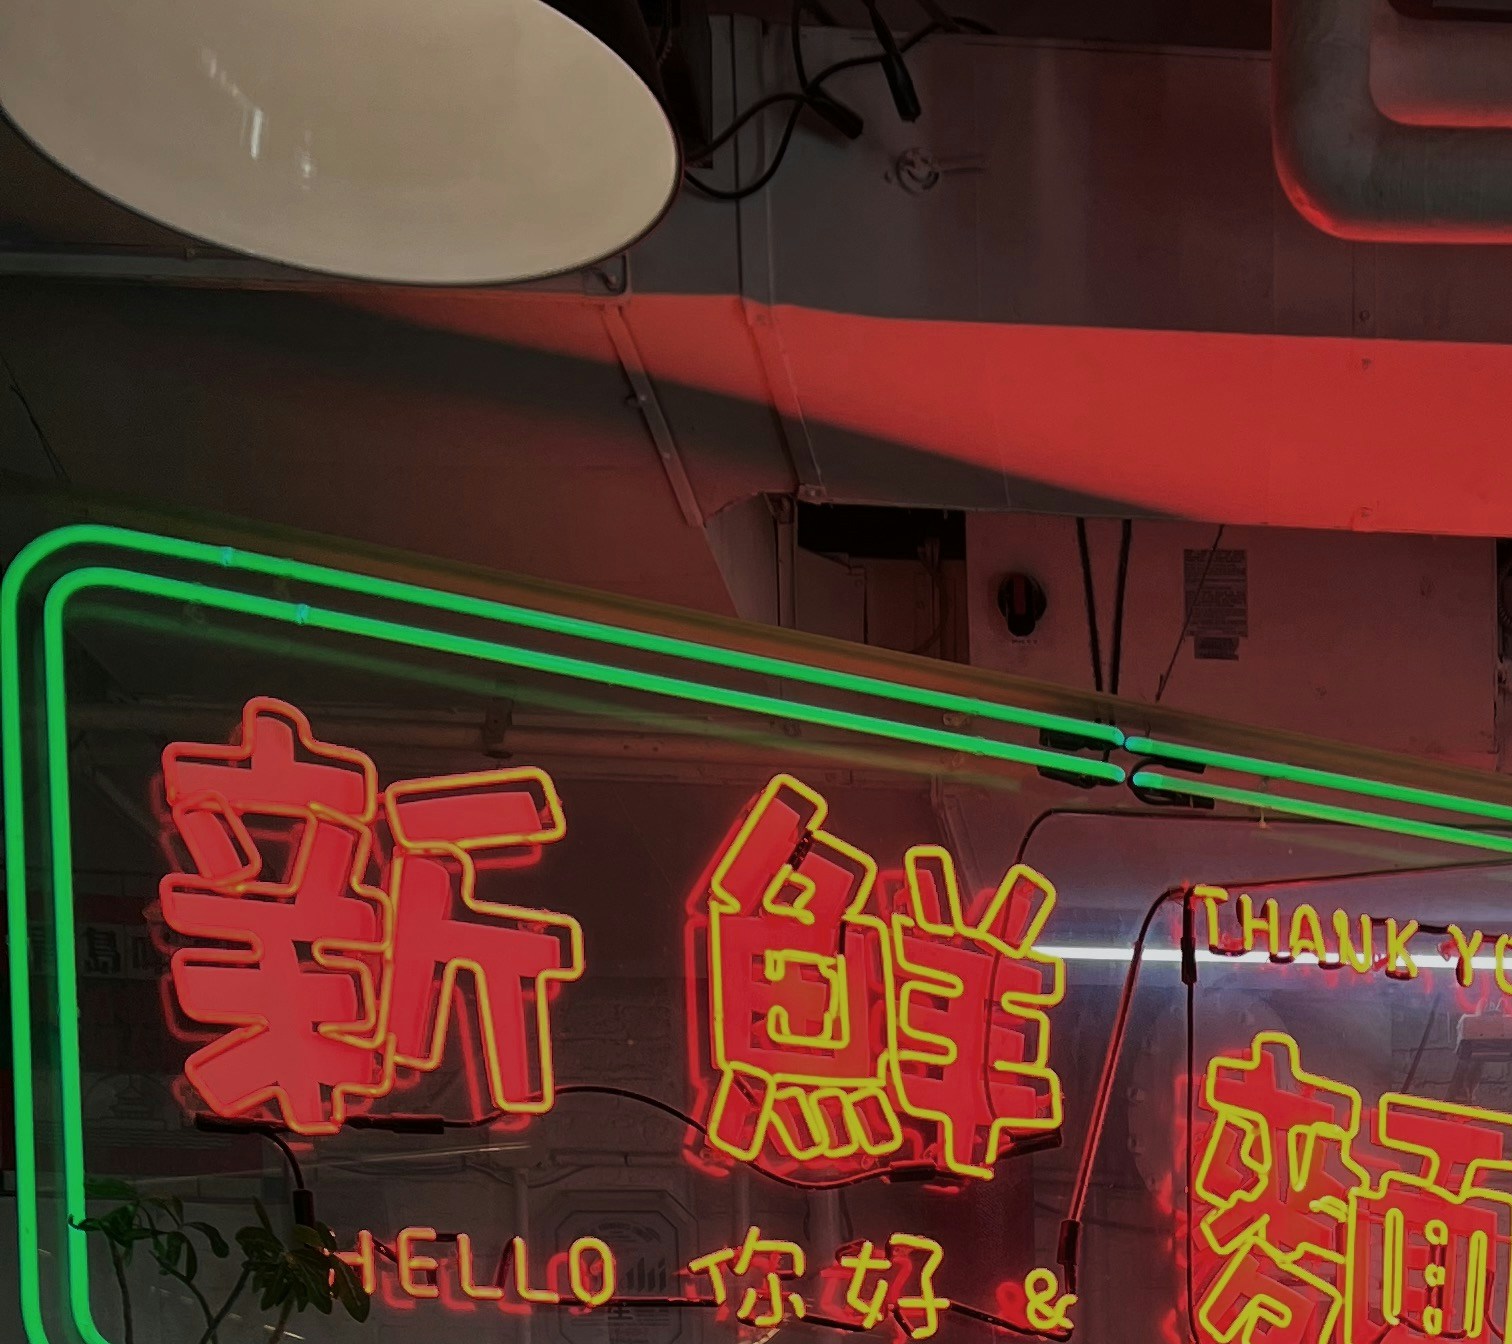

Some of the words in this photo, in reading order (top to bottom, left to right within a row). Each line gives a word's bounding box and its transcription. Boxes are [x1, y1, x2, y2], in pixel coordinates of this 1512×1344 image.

[1194, 885, 1419, 979] THANK
[326, 1226, 616, 1304] HELLO
[689, 1226, 949, 1340] 你好
[1023, 1267, 1076, 1333] &
